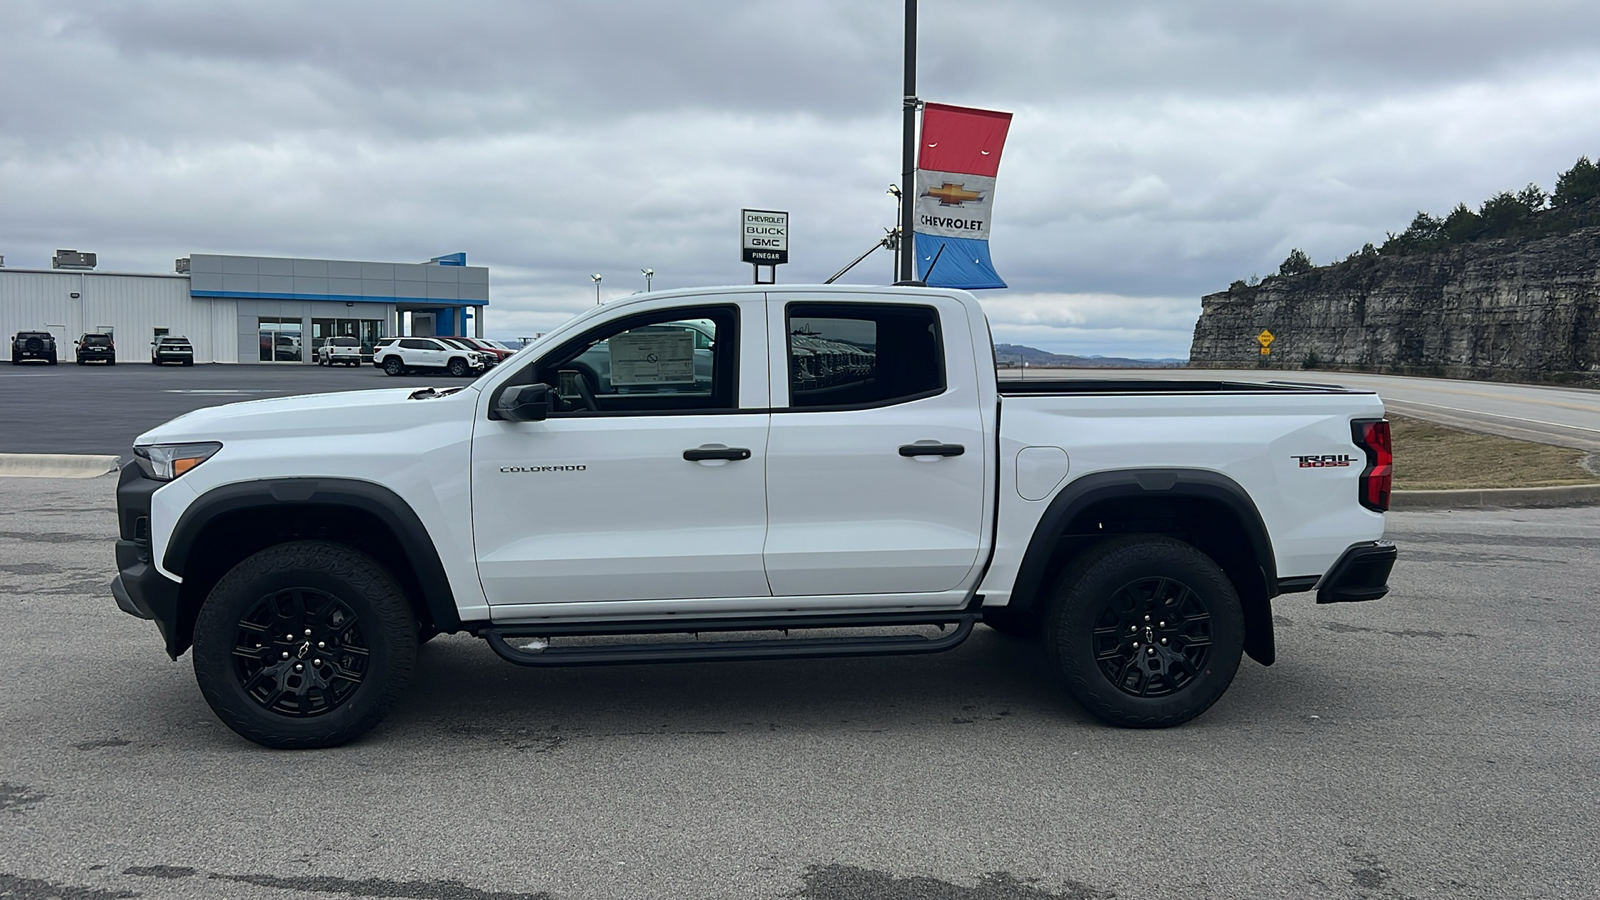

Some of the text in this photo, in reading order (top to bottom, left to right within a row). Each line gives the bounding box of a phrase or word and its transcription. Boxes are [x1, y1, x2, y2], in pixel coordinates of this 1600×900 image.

[747, 215, 785, 224] CHEVROLET
[746, 226, 785, 236] BUICK
[752, 238, 780, 247] GMC
[752, 252, 780, 260] PINEGAR
[1290, 454, 1358, 463] TRAIL
[500, 464, 587, 473] COLORADO
